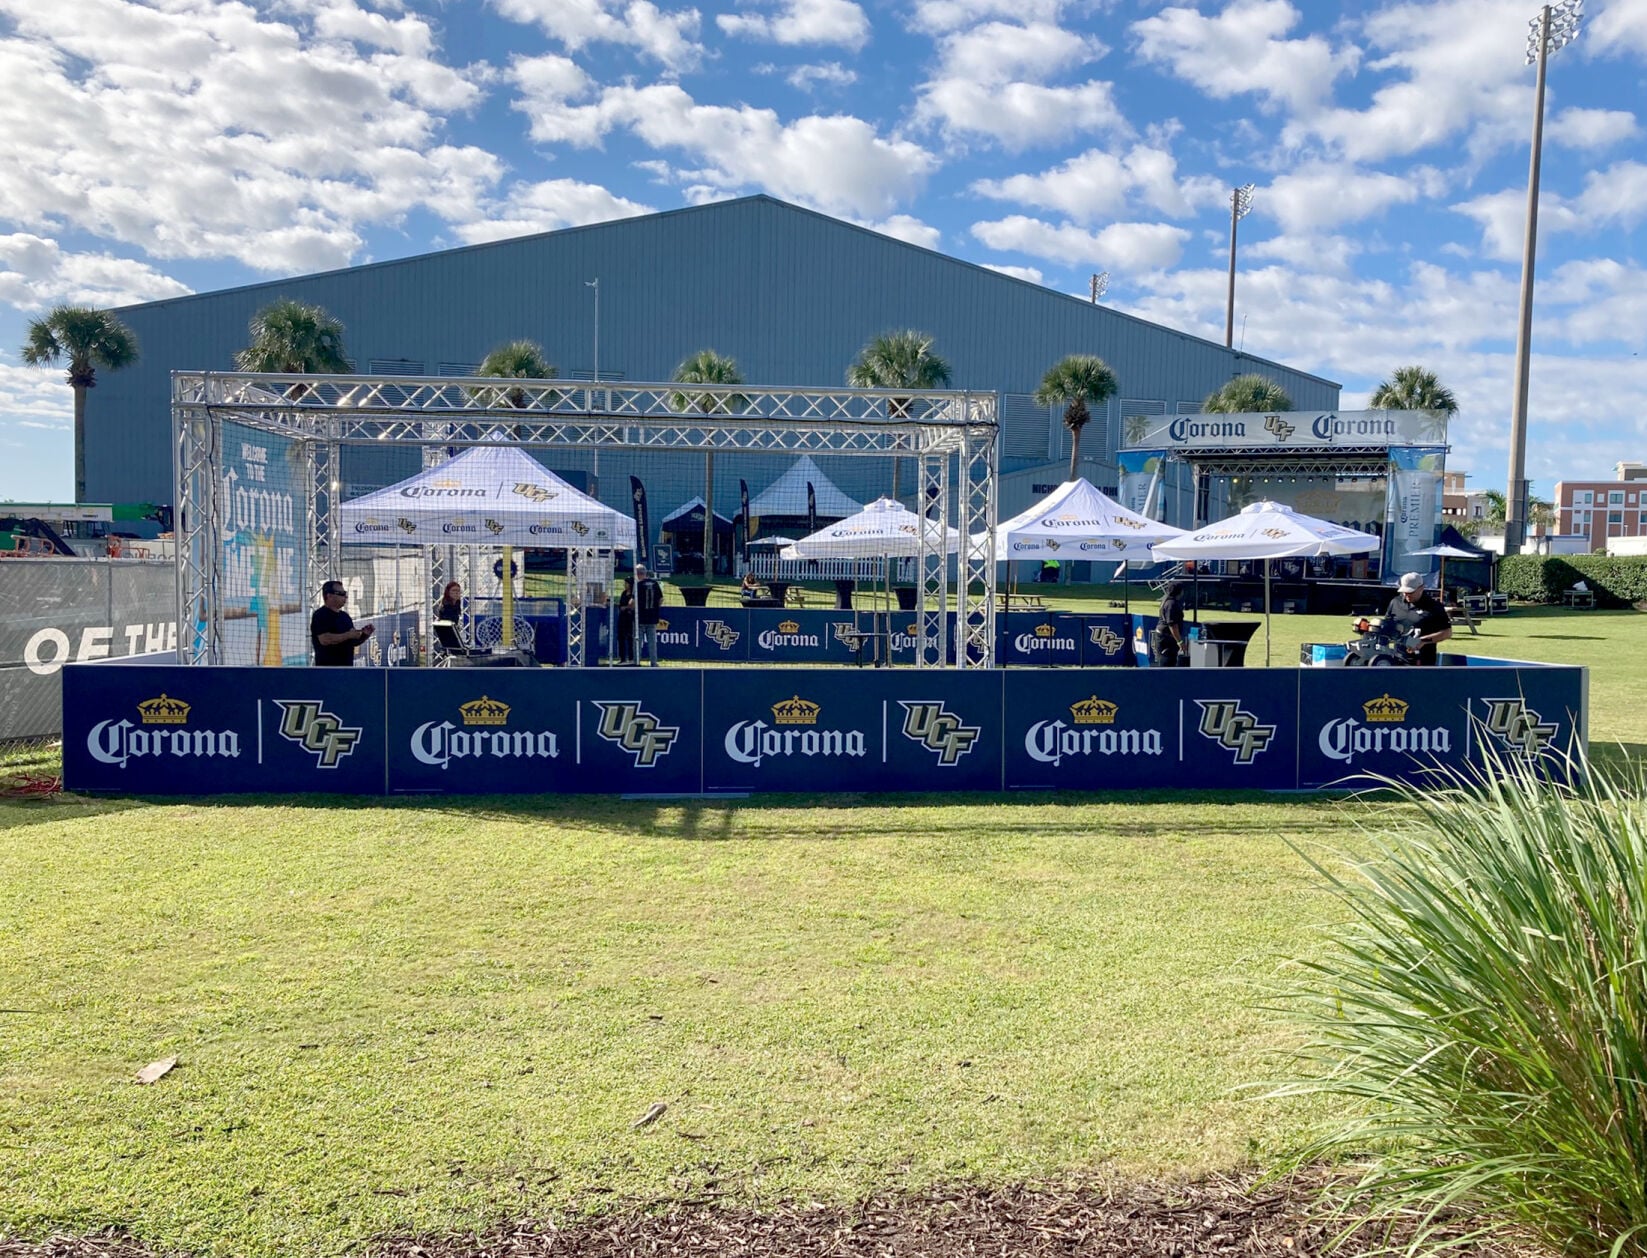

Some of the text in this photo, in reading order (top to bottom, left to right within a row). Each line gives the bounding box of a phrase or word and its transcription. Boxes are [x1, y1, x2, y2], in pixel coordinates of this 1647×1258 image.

[1169, 413, 1396, 443] Corona UCF Corona
[400, 486, 486, 498] Corona
[512, 483, 559, 502] UCF
[1409, 478, 1421, 537] PREMIER
[355, 518, 590, 537] Corona UCF Corona UCF Corona UCF
[1041, 518, 1101, 528] Corona
[1193, 532, 1245, 542] Corona
[1013, 542, 1040, 551] Corona
[1080, 542, 1106, 551] Corona
[703, 619, 740, 650] UCF
[758, 629, 819, 650] Corona
[1014, 632, 1075, 655] Corona
[1088, 625, 1126, 656] UCF
[24, 627, 113, 675] OF
[87, 699, 363, 768] Corona UCF
[410, 700, 680, 769] Corona UCF
[724, 700, 981, 767] Corona UCF
[1025, 699, 1276, 766] Corona UCF
[1318, 697, 1559, 764] Corona UCF
